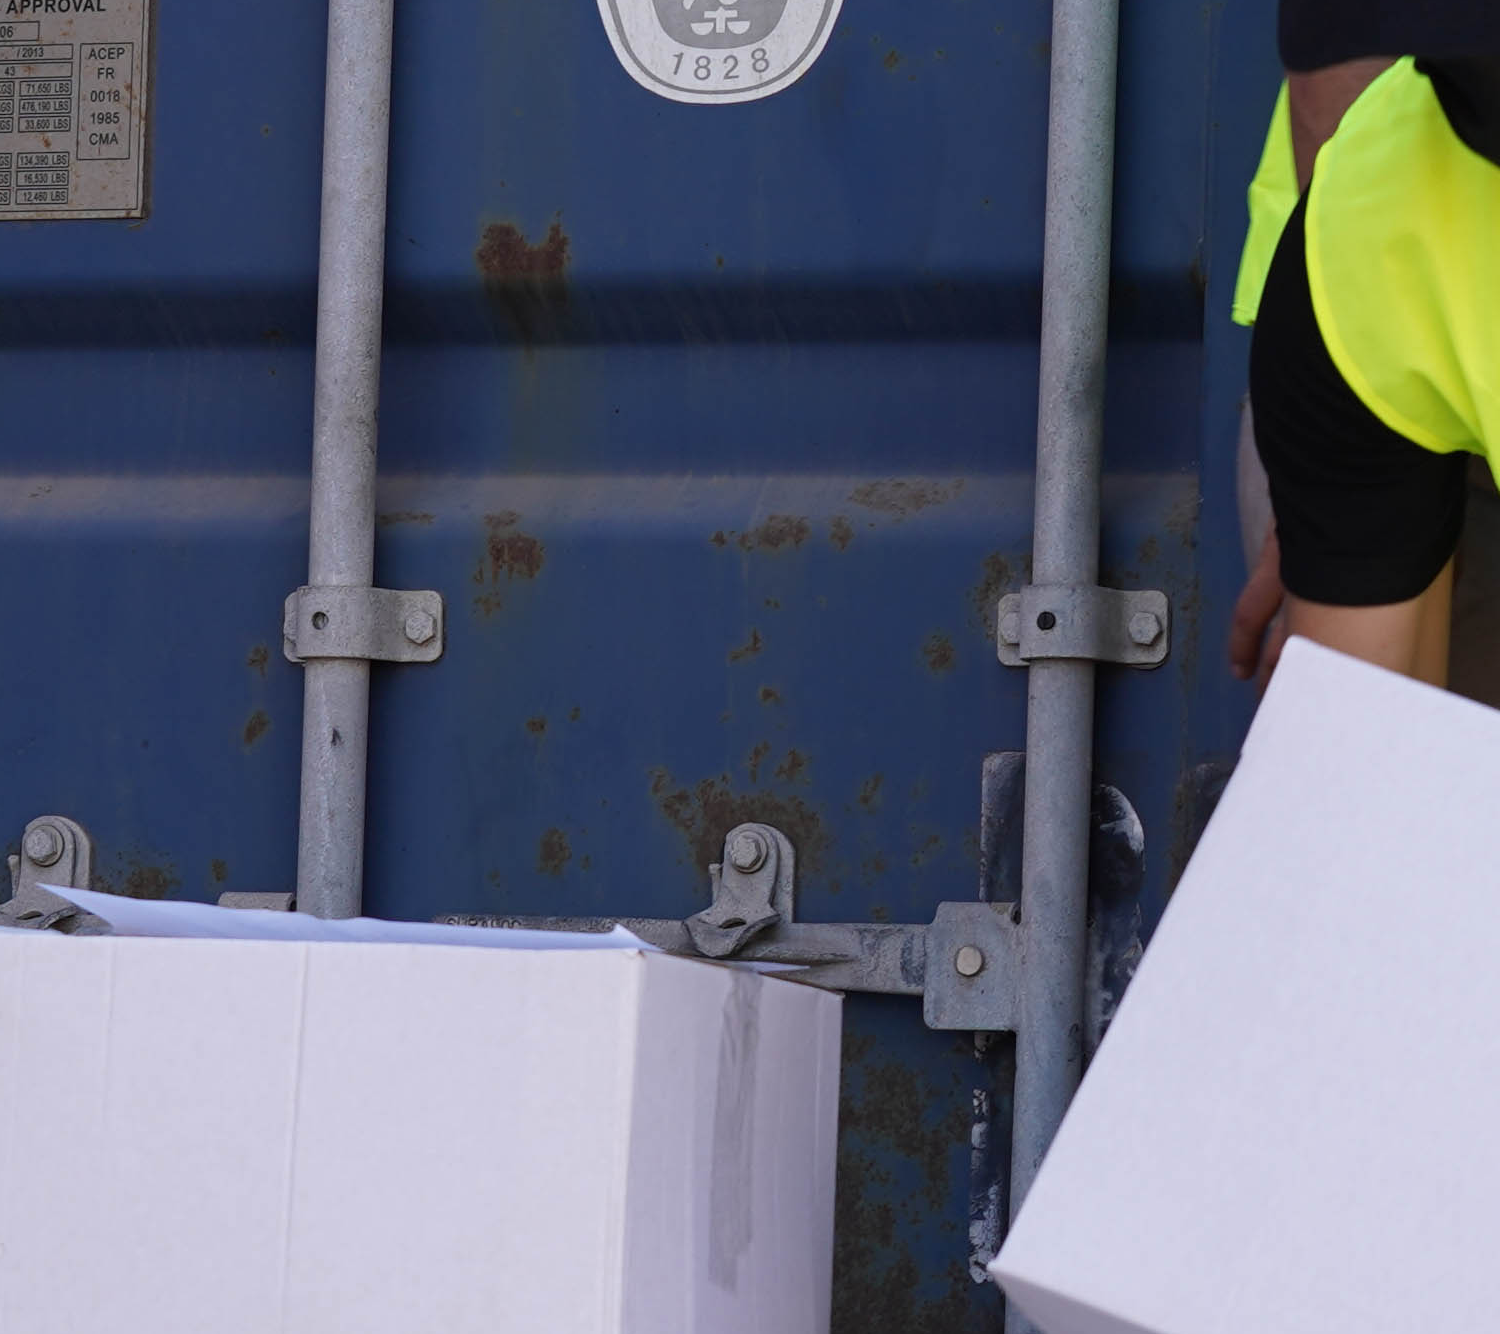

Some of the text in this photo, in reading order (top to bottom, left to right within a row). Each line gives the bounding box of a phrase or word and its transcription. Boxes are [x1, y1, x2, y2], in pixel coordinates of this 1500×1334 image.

[89, 47, 125, 60] ACEP
[672, 48, 771, 81] 1828
[4, 67, 15, 76] 43
[97, 68, 115, 80] FR
[91, 113, 120, 124] 1985
[89, 133, 118, 145] CMA
